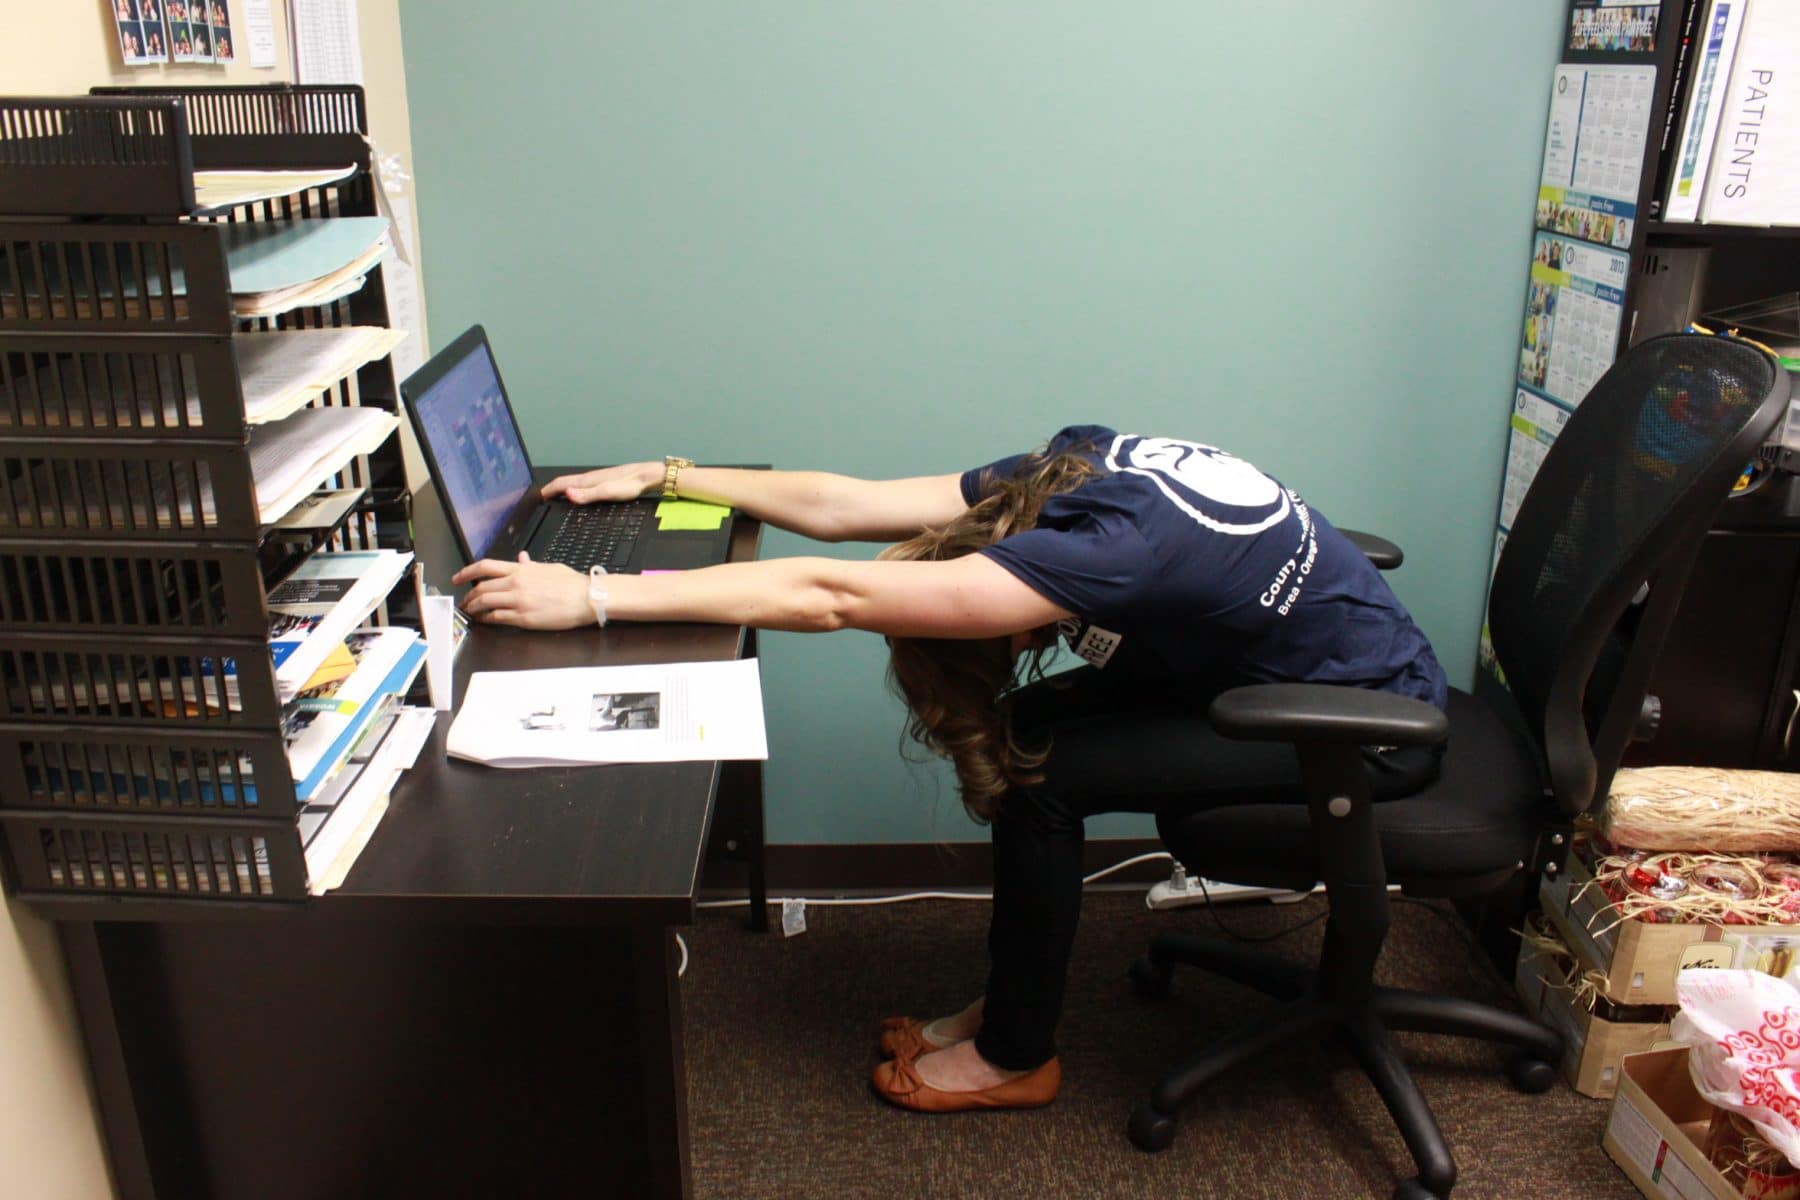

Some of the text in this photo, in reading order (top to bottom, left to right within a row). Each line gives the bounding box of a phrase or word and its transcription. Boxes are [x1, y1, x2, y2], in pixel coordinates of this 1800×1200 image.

[1724, 69, 1774, 198] PATIENTS
[1259, 558, 1297, 608] Coury
[1277, 586, 1301, 617] Brea
